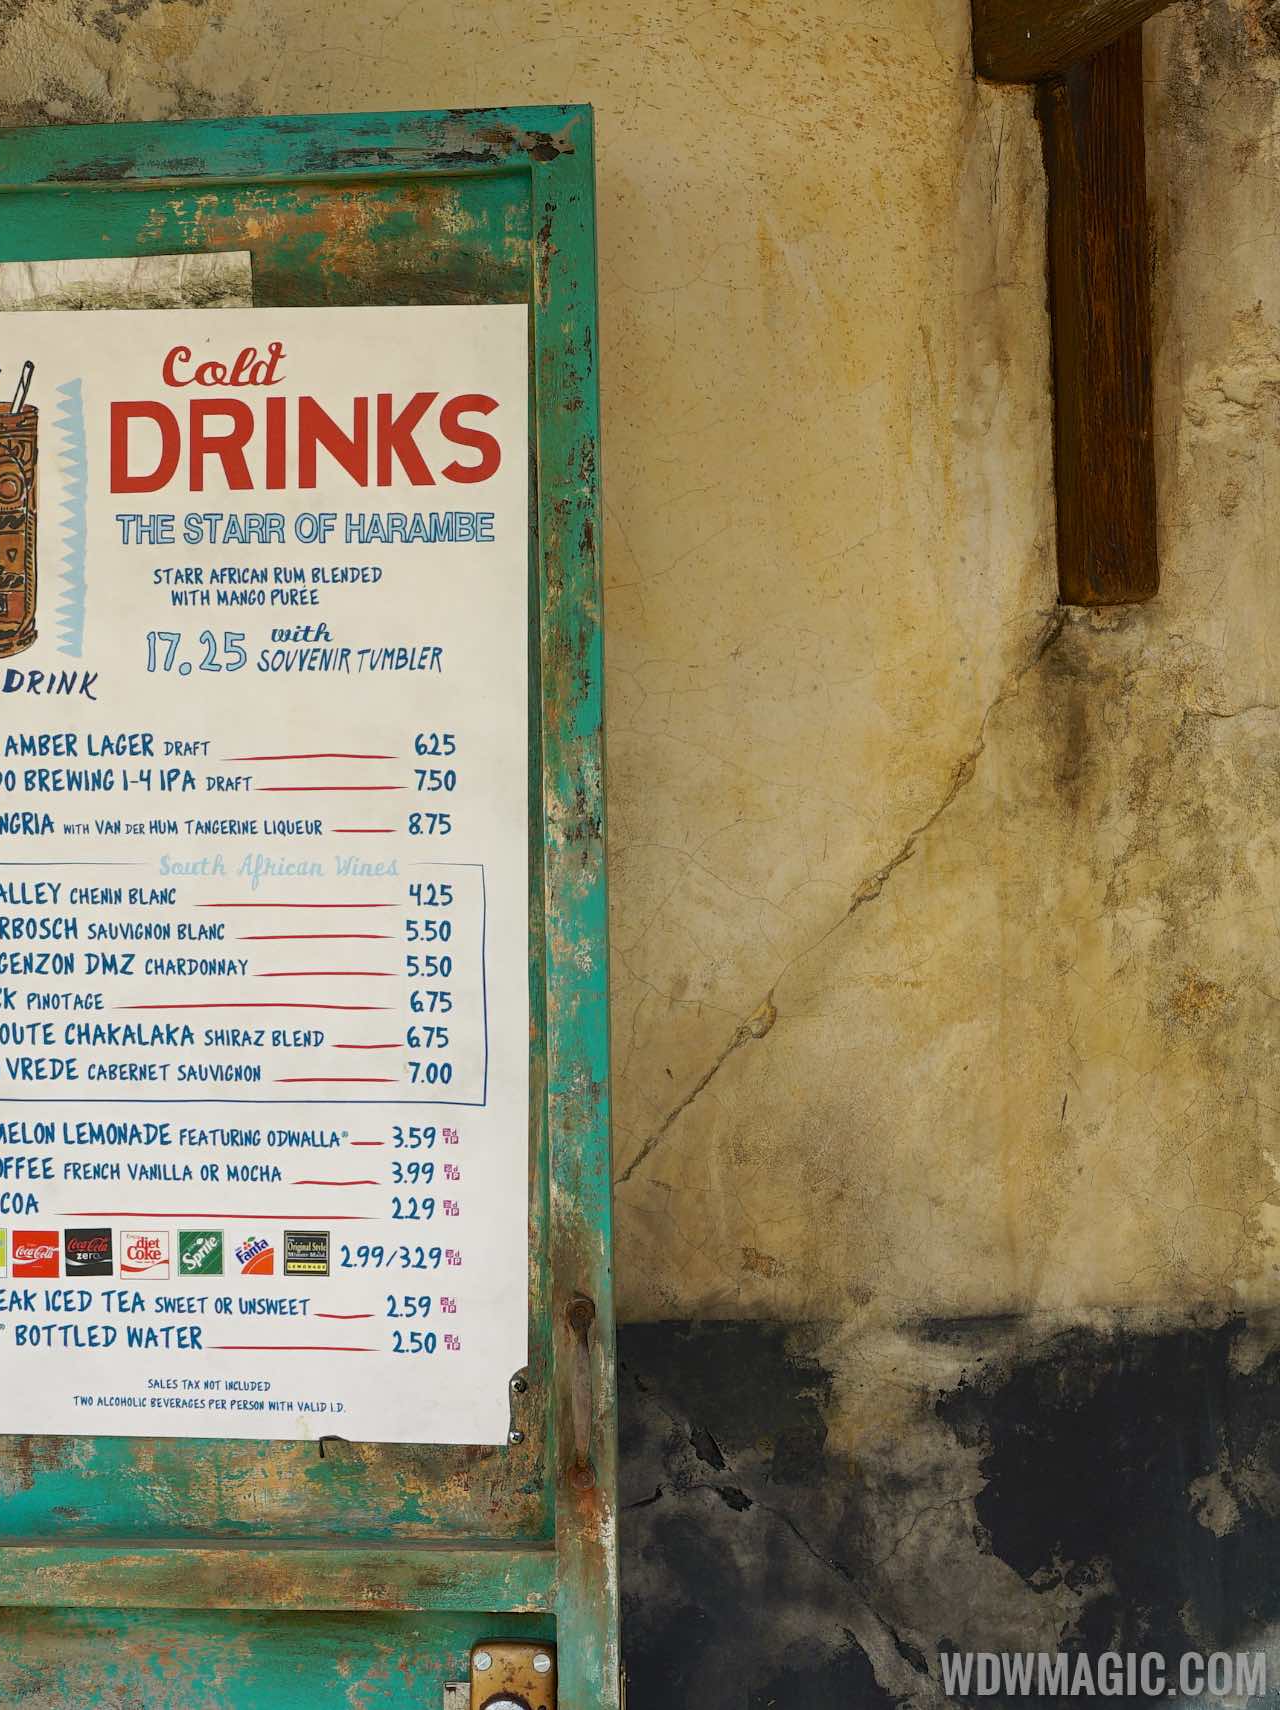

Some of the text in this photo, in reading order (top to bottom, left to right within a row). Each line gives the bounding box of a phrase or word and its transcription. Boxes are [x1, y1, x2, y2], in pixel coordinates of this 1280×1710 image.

[162, 342, 287, 387] Cold
[110, 392, 502, 494] DRINKS
[116, 511, 495, 545] THE STARR OF HARAMBE
[153, 566, 383, 586] STARR AFRICAN RUM BLENDED
[171, 589, 212, 607] WITH
[217, 589, 266, 607] MANGO
[271, 624, 335, 643] with
[146, 630, 443, 676] 17.25 SOUVENIR TUMBLER
[2, 668, 99, 701] DRINK
[5, 733, 78, 757] AMBER
[87, 733, 154, 757] LAGER
[164, 741, 210, 757] DRAFT
[24, 768, 114, 792] BREWING
[160, 768, 196, 792] IPA
[205, 776, 253, 792] DRAFT
[414, 768, 457, 792] 7.50
[63, 823, 90, 834] WITH
[95, 820, 120, 834] VAN
[125, 823, 145, 834] DER
[149, 820, 178, 834] HUM
[185, 820, 258, 835] TANGERINE
[264, 820, 322, 836] LIQUEUR
[408, 812, 452, 834] 8.75
[160, 853, 400, 889] South African Wines
[70, 888, 121, 905] CHENIN
[128, 888, 176, 905] BLANC
[87, 923, 170, 940] SAUVIGNON
[177, 923, 225, 940] BLANC
[406, 920, 452, 942] 5.50
[84, 952, 136, 975] DMZ
[145, 958, 248, 976] CHARDONNAY
[406, 955, 452, 977] 5.50
[26, 992, 104, 1010] PINOTAGE
[64, 1023, 195, 1046] CHAKALAKA
[204, 1029, 265, 1046] SHIRAZ
[272, 1029, 325, 1046] BLEND
[5, 1057, 79, 1081] VREDE
[87, 1063, 170, 1081] CABERNET
[177, 1064, 261, 1082] SAUVIGNON
[407, 1061, 452, 1084] 7.00
[63, 1121, 171, 1145] LEMONADE
[179, 1128, 261, 1147] FEATURING
[391, 1126, 436, 1149] 3.59
[64, 1163, 120, 1180] FRENCH
[127, 1164, 193, 1181] VANILLA
[200, 1164, 219, 1181] OR
[227, 1165, 282, 1182] MOCHA
[391, 1161, 435, 1184] 3.99
[127, 1245, 161, 1260] Coke
[136, 1236, 160, 1249] diet
[182, 1236, 219, 1271] Sprite
[235, 1239, 269, 1264] Fanta
[45, 1290, 92, 1312] ICED
[101, 1290, 145, 1313] TEA
[155, 1297, 208, 1313] SWEET
[215, 1297, 233, 1314] OR
[239, 1299, 310, 1315] UNSWEET
[386, 1295, 431, 1317] 2.59
[15, 1324, 117, 1347] BOTTLED
[127, 1325, 202, 1350] WATER
[392, 1330, 436, 1354] 2.50
[148, 1379, 271, 1391] SALES TAX NOT INCLUDED
[73, 1396, 93, 1405] TWO
[97, 1397, 147, 1408] ALCOHOLIC
[151, 1398, 205, 1409] BEVERAGES
[209, 1399, 227, 1410] PER
[230, 1400, 264, 1411] PERSON
[268, 1401, 293, 1411] WITH
[297, 1402, 327, 1412] VALID
